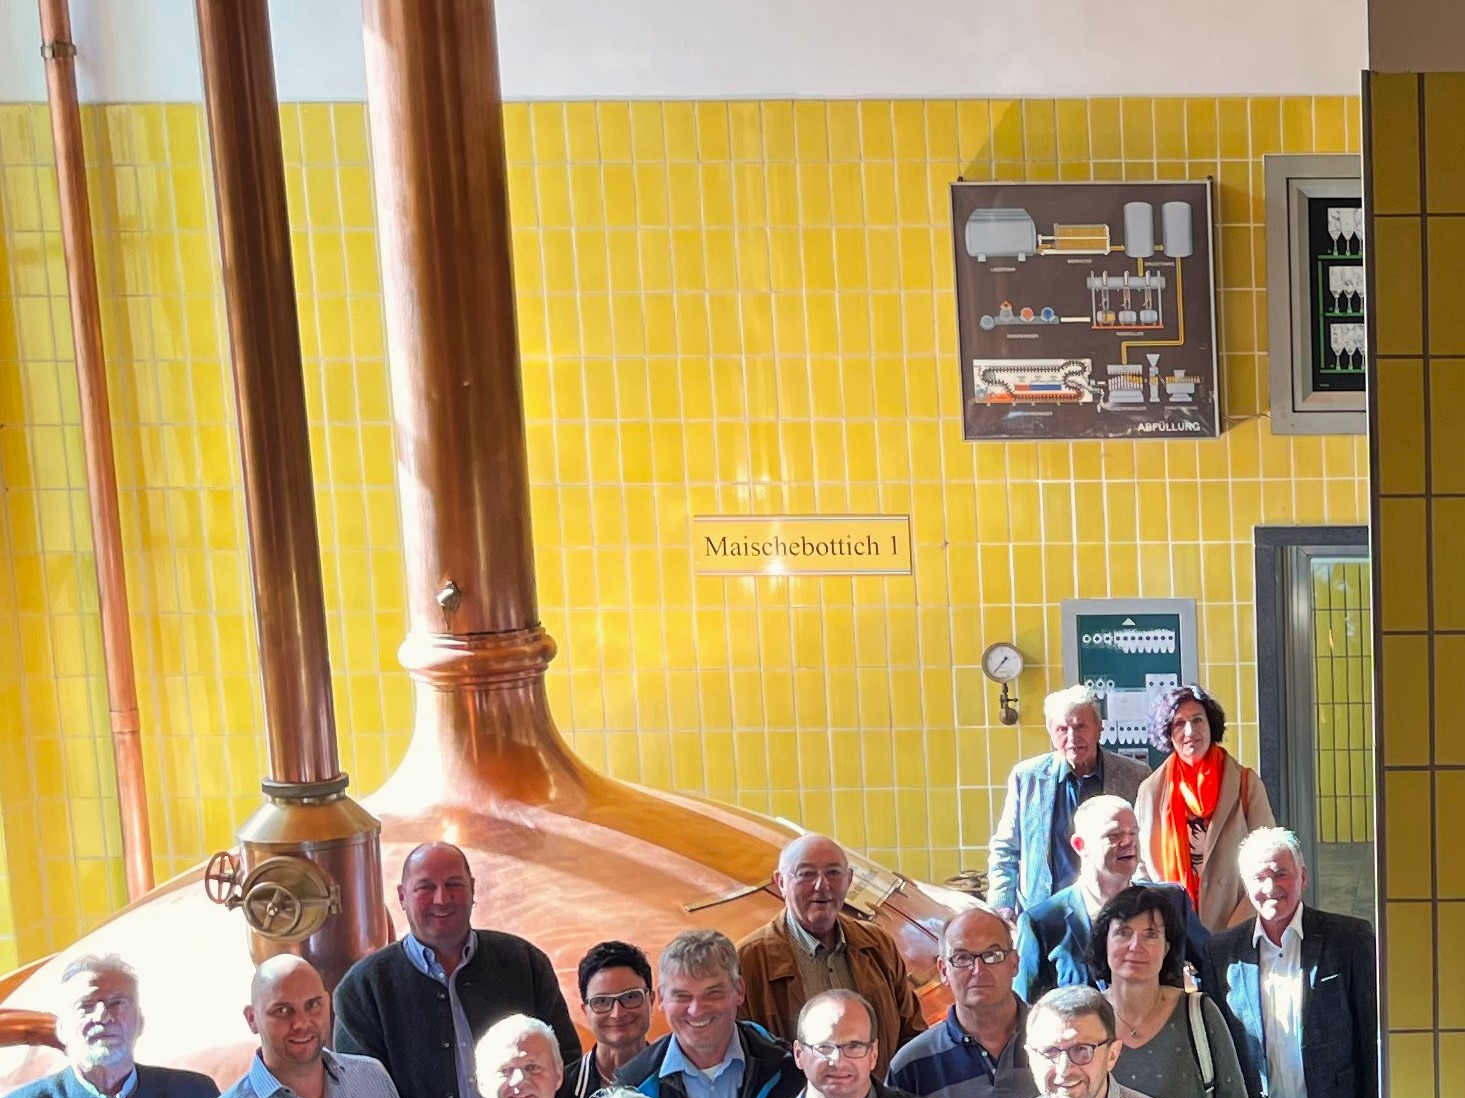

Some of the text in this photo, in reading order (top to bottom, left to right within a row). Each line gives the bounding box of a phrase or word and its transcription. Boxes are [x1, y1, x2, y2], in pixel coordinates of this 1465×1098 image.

[1137, 420, 1201, 432] ABFÜLLUNG
[704, 534, 898, 557] Maischebottich 1
